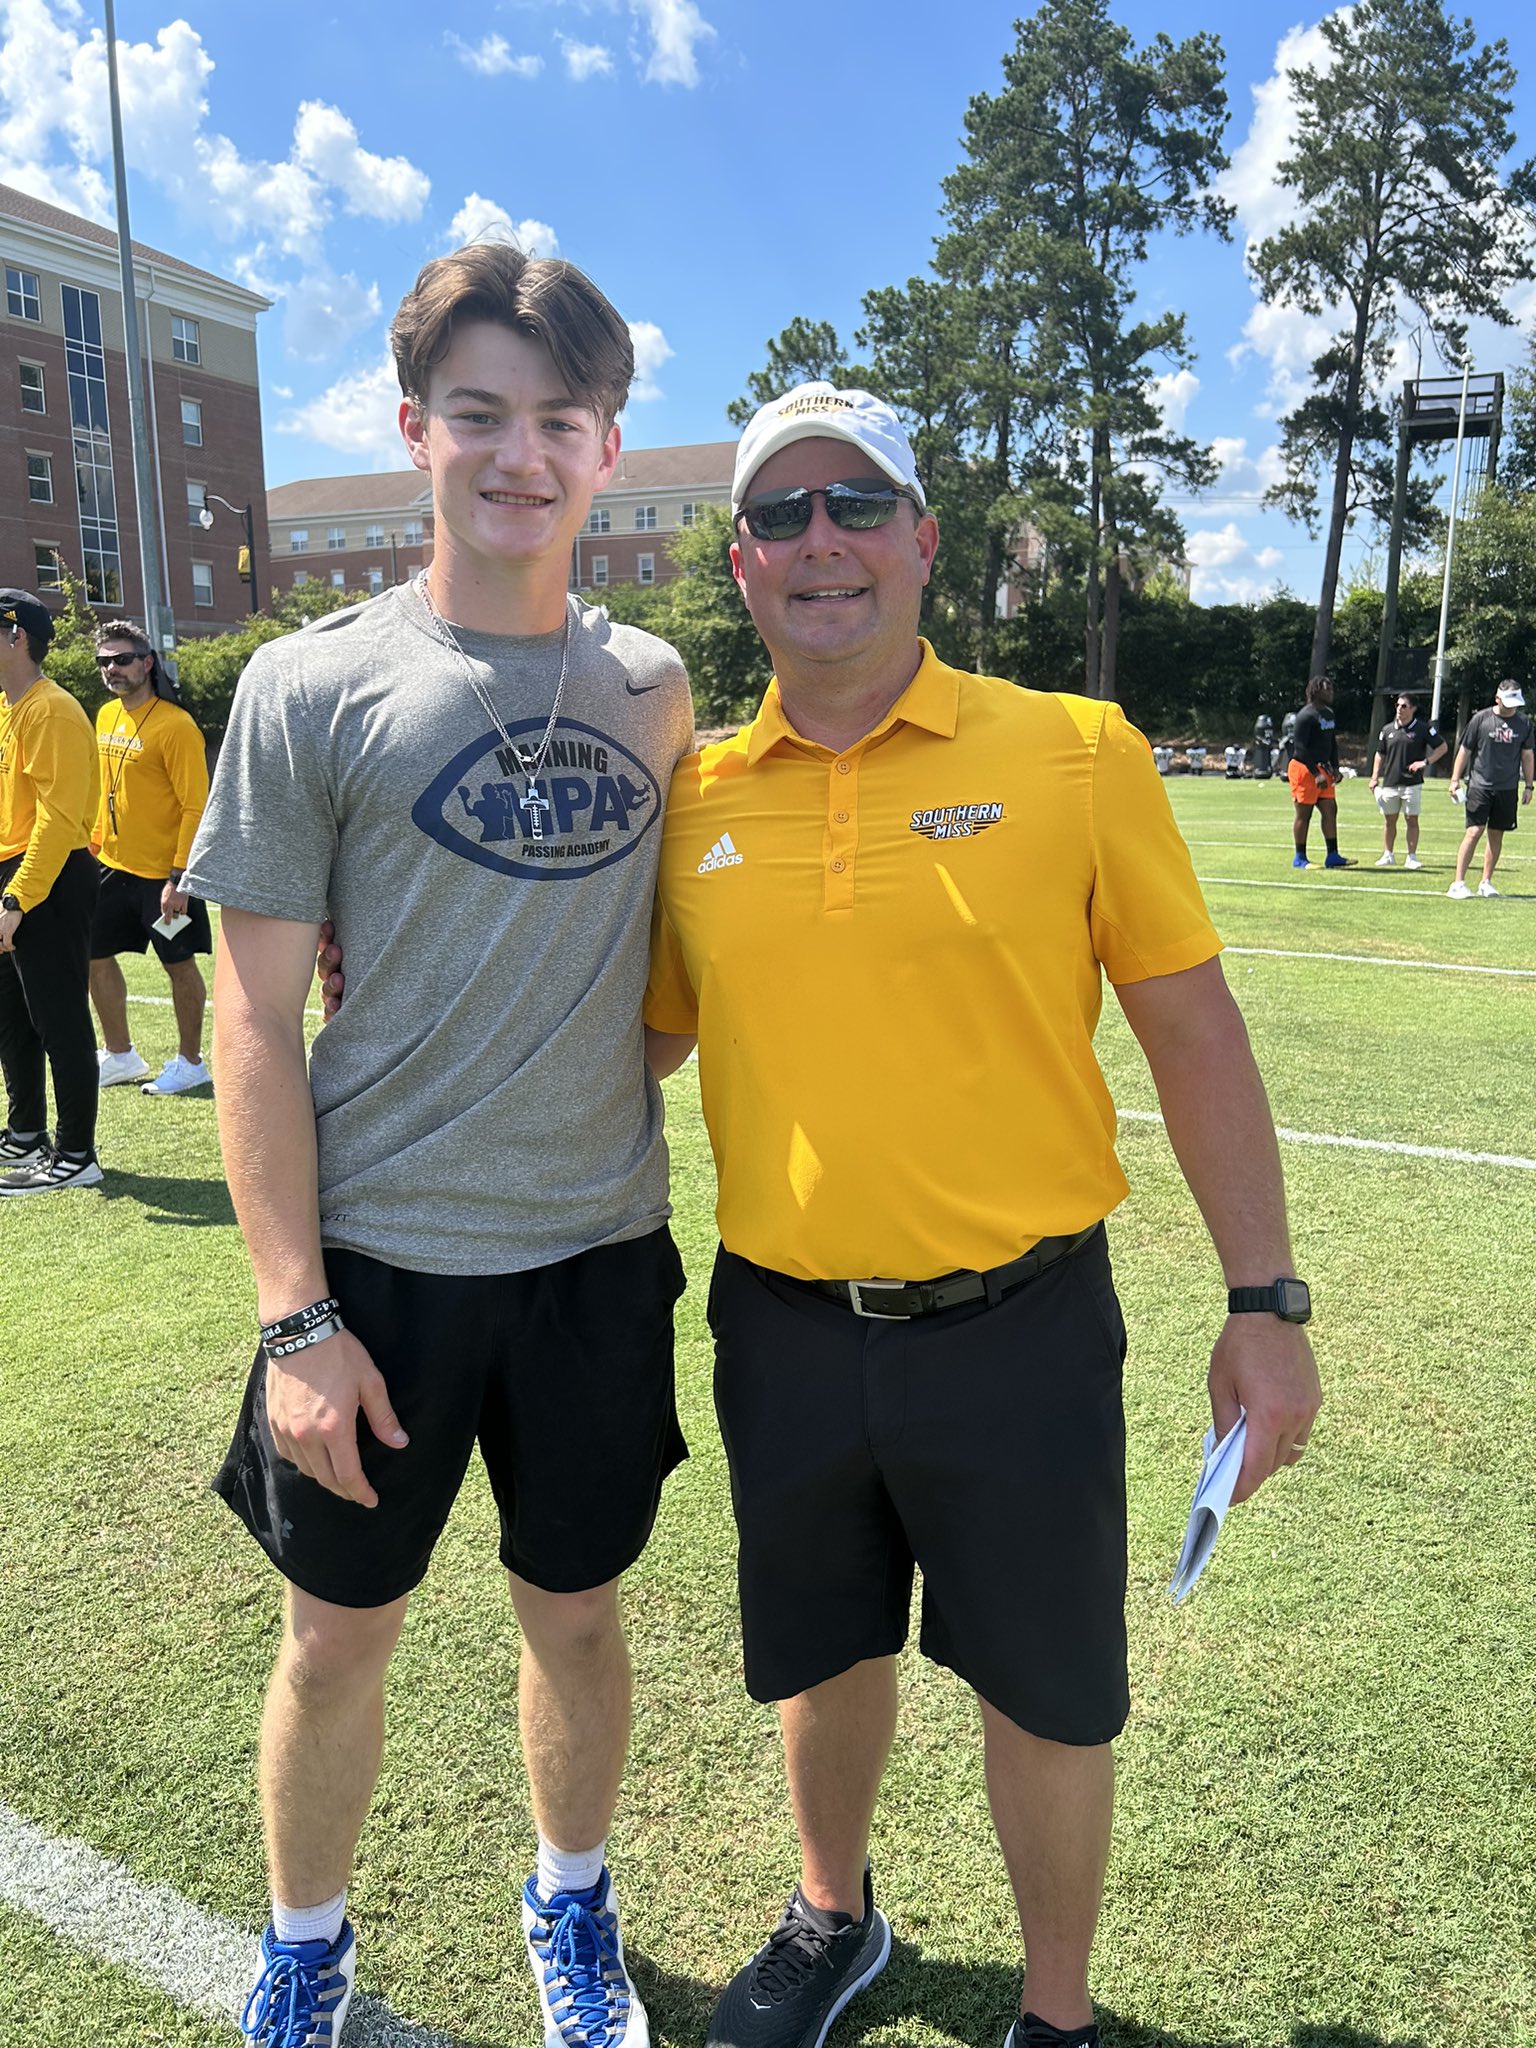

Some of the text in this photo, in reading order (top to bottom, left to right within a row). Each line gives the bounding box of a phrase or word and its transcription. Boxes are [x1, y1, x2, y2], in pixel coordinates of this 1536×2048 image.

[778, 396, 854, 416] SOUTHERN
[796, 406, 829, 416] MISS
[910, 803, 1004, 829] SOUTHERN
[933, 820, 973, 840] MISS
[521, 838, 611, 858] PASSING ACADEMY
[697, 852, 745, 874] adidas
[301, 1301, 330, 1319] 4:13
